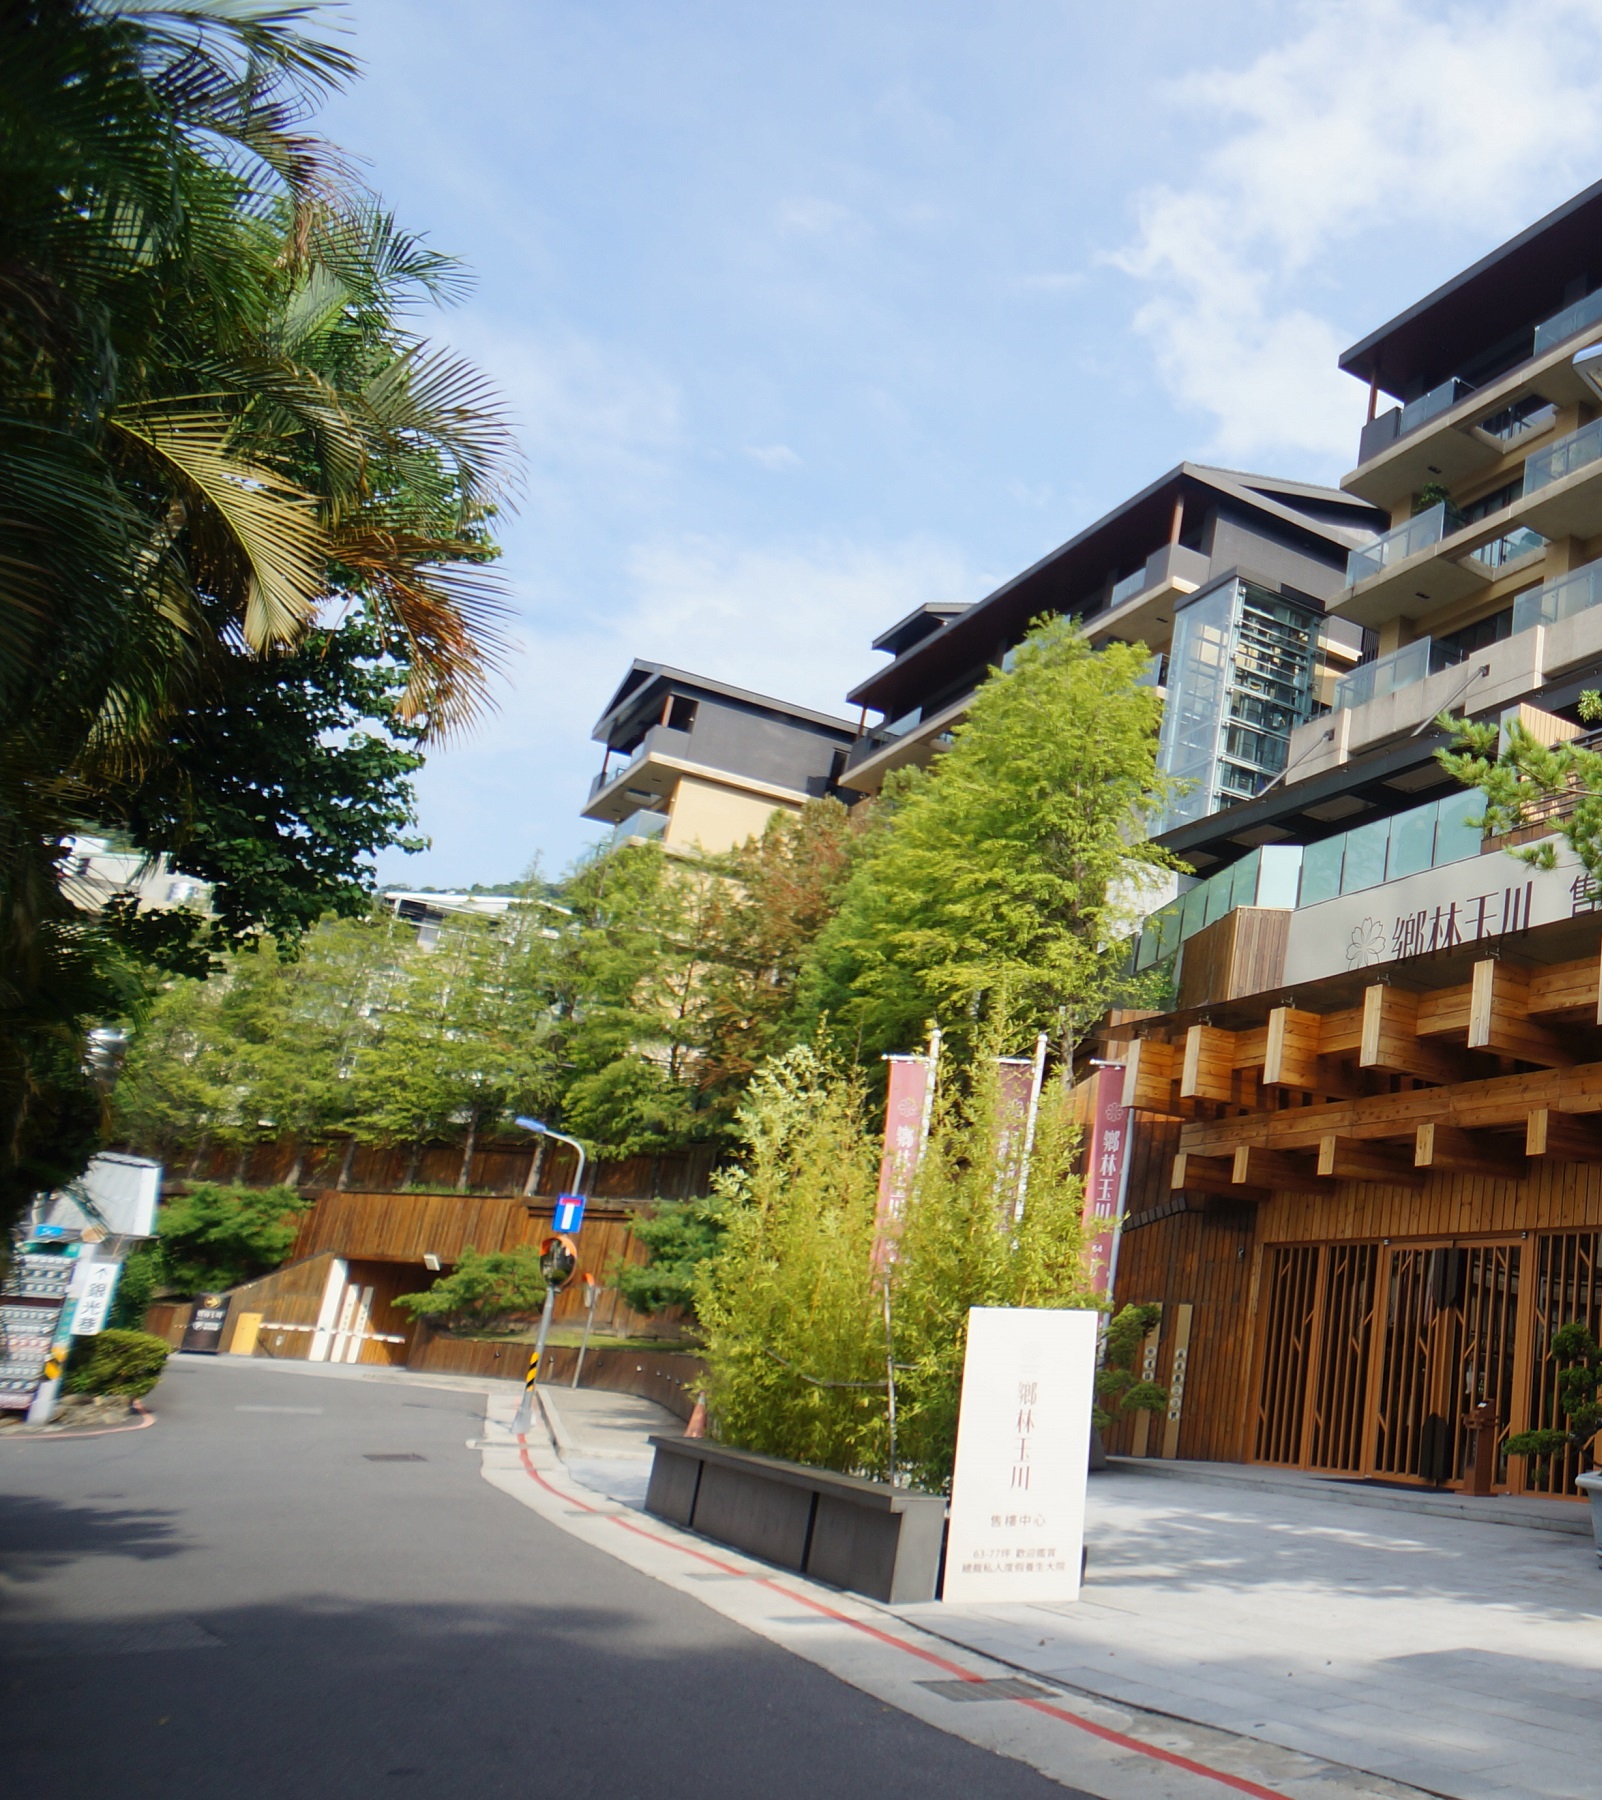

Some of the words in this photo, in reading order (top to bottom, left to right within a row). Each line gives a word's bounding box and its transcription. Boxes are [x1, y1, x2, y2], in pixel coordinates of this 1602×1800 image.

[1391, 880, 1534, 966] 鄉林玉川
[1095, 1130, 1121, 1220] 鄉林玉川
[1011, 1381, 1037, 1490] 鄉林玉川
